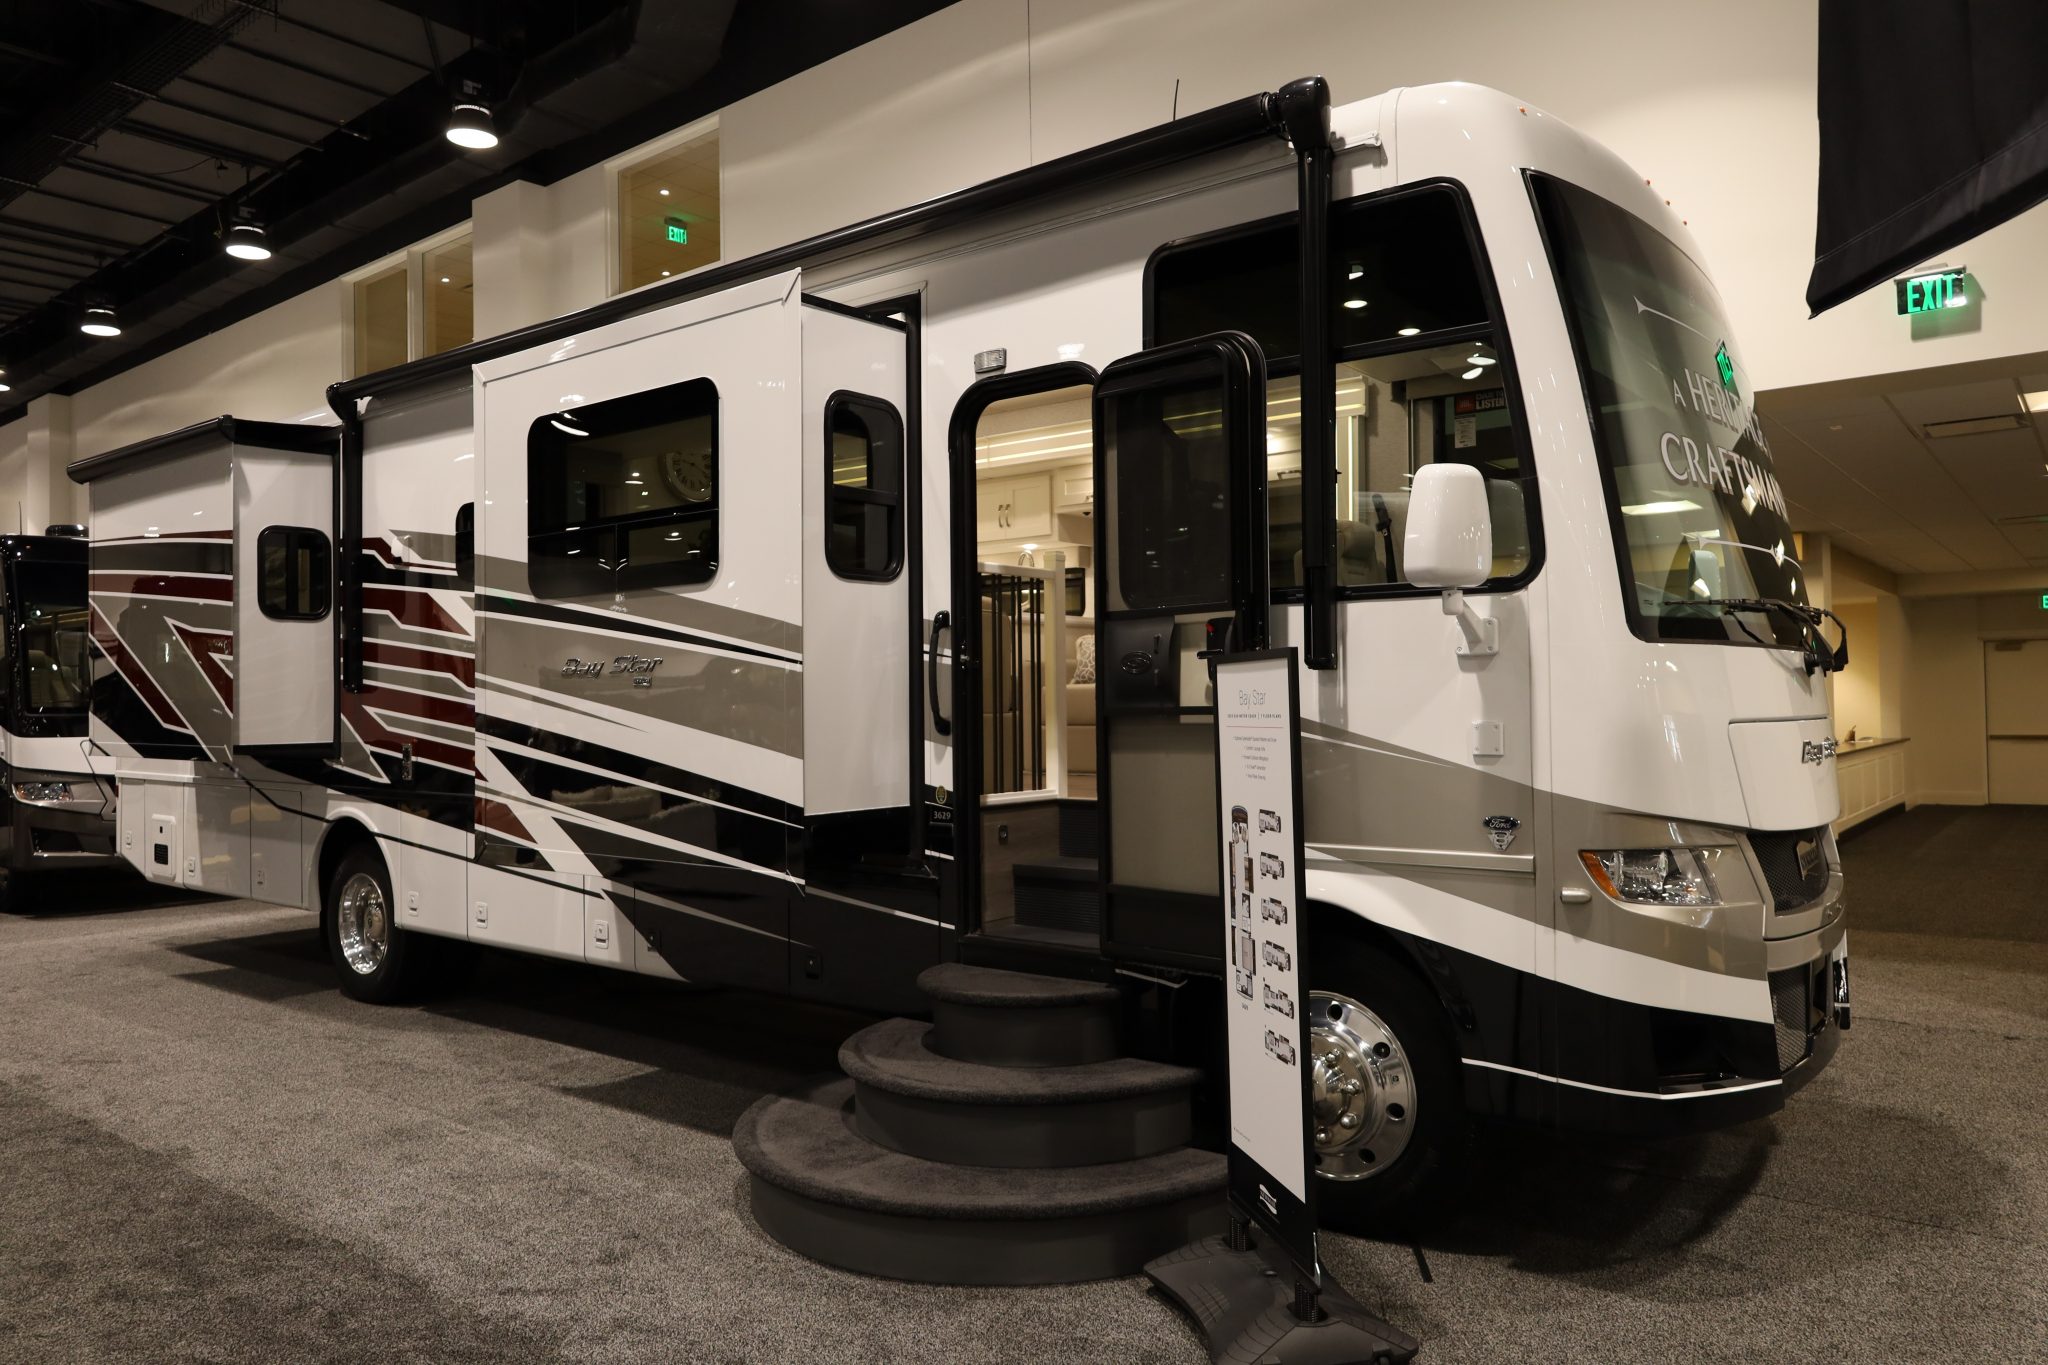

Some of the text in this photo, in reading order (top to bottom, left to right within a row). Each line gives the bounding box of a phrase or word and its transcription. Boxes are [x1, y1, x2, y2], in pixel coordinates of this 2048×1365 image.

[669, 226, 686, 244] EXIT
[1907, 273, 1956, 313] EXIT
[1673, 378, 1686, 407] A
[561, 655, 664, 679] Bay Star
[1239, 689, 1267, 710] Bay Star
[933, 811, 951, 820] 3629
[1489, 818, 1511, 828] Ford
